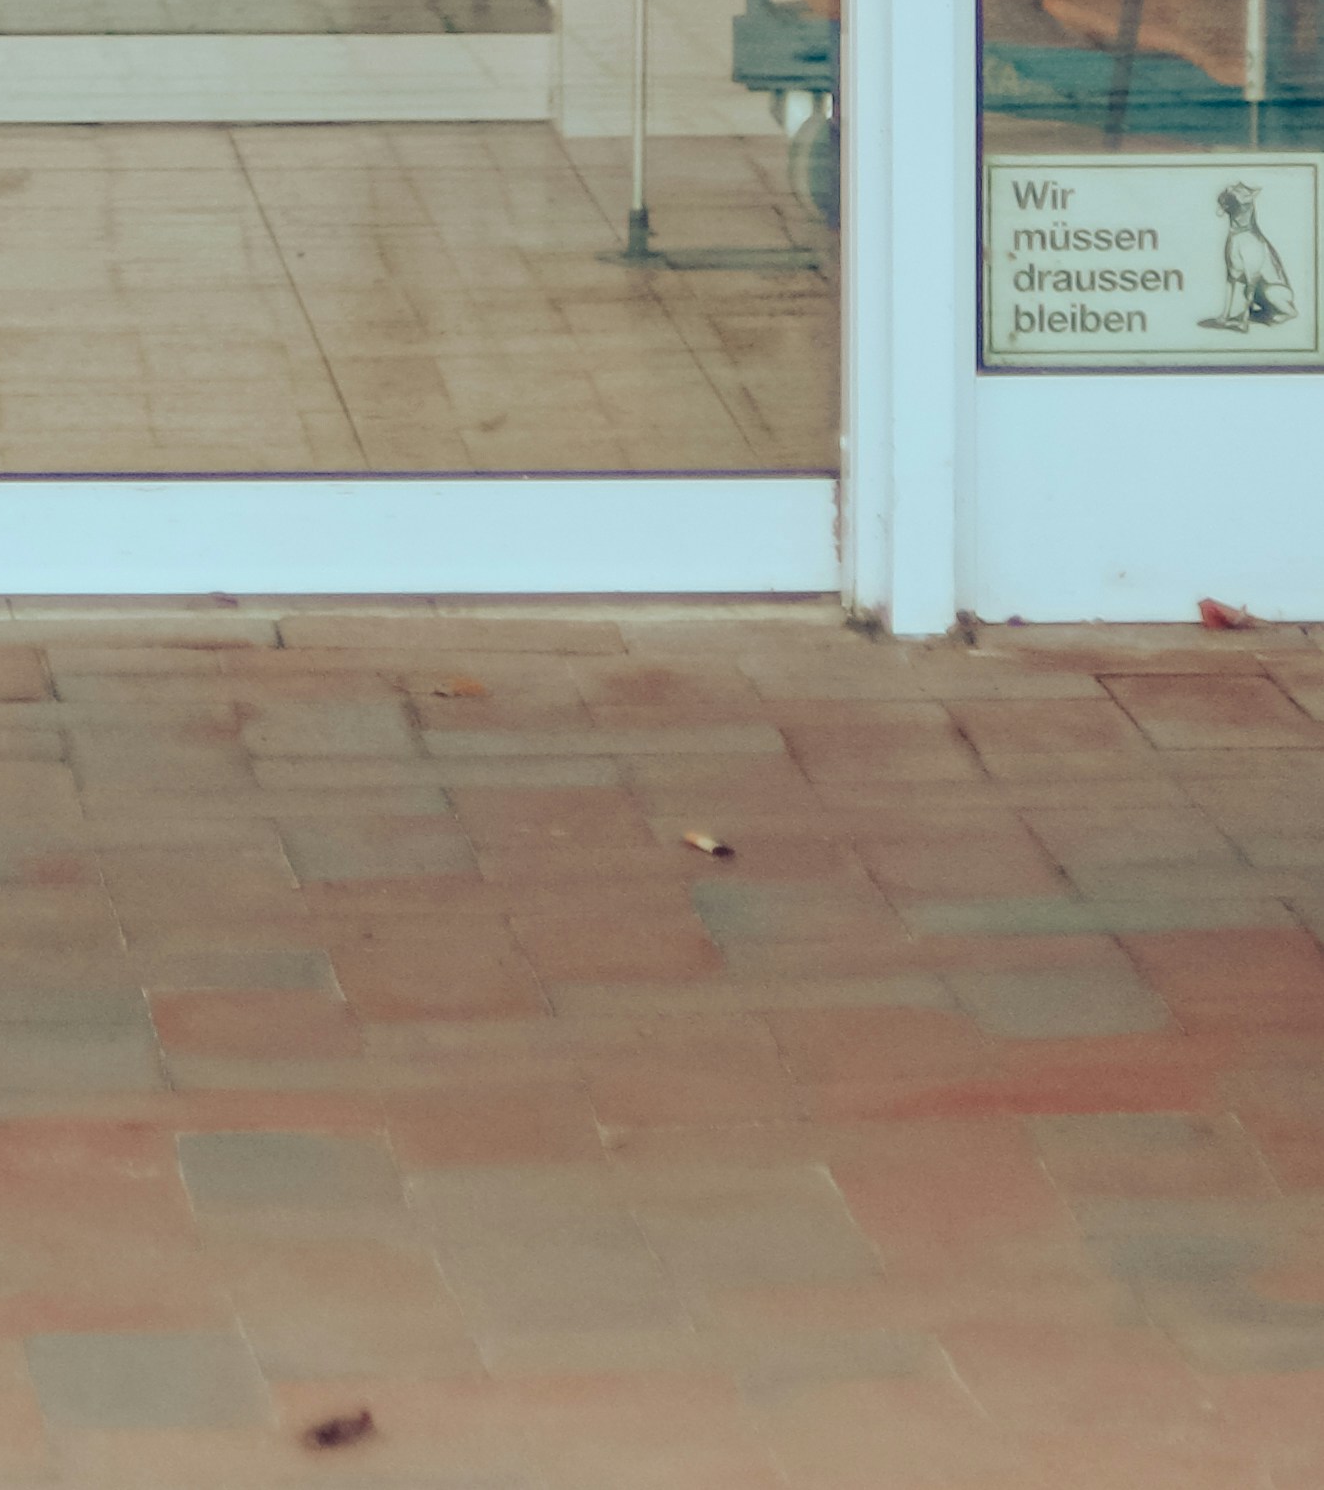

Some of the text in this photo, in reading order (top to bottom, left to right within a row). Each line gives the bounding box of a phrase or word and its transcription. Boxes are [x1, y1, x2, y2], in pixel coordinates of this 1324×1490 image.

[1012, 180, 1075, 211] Wir
[1013, 222, 1159, 252] müssen
[1013, 264, 1184, 293] draussen
[1013, 303, 1147, 334] bleiben
